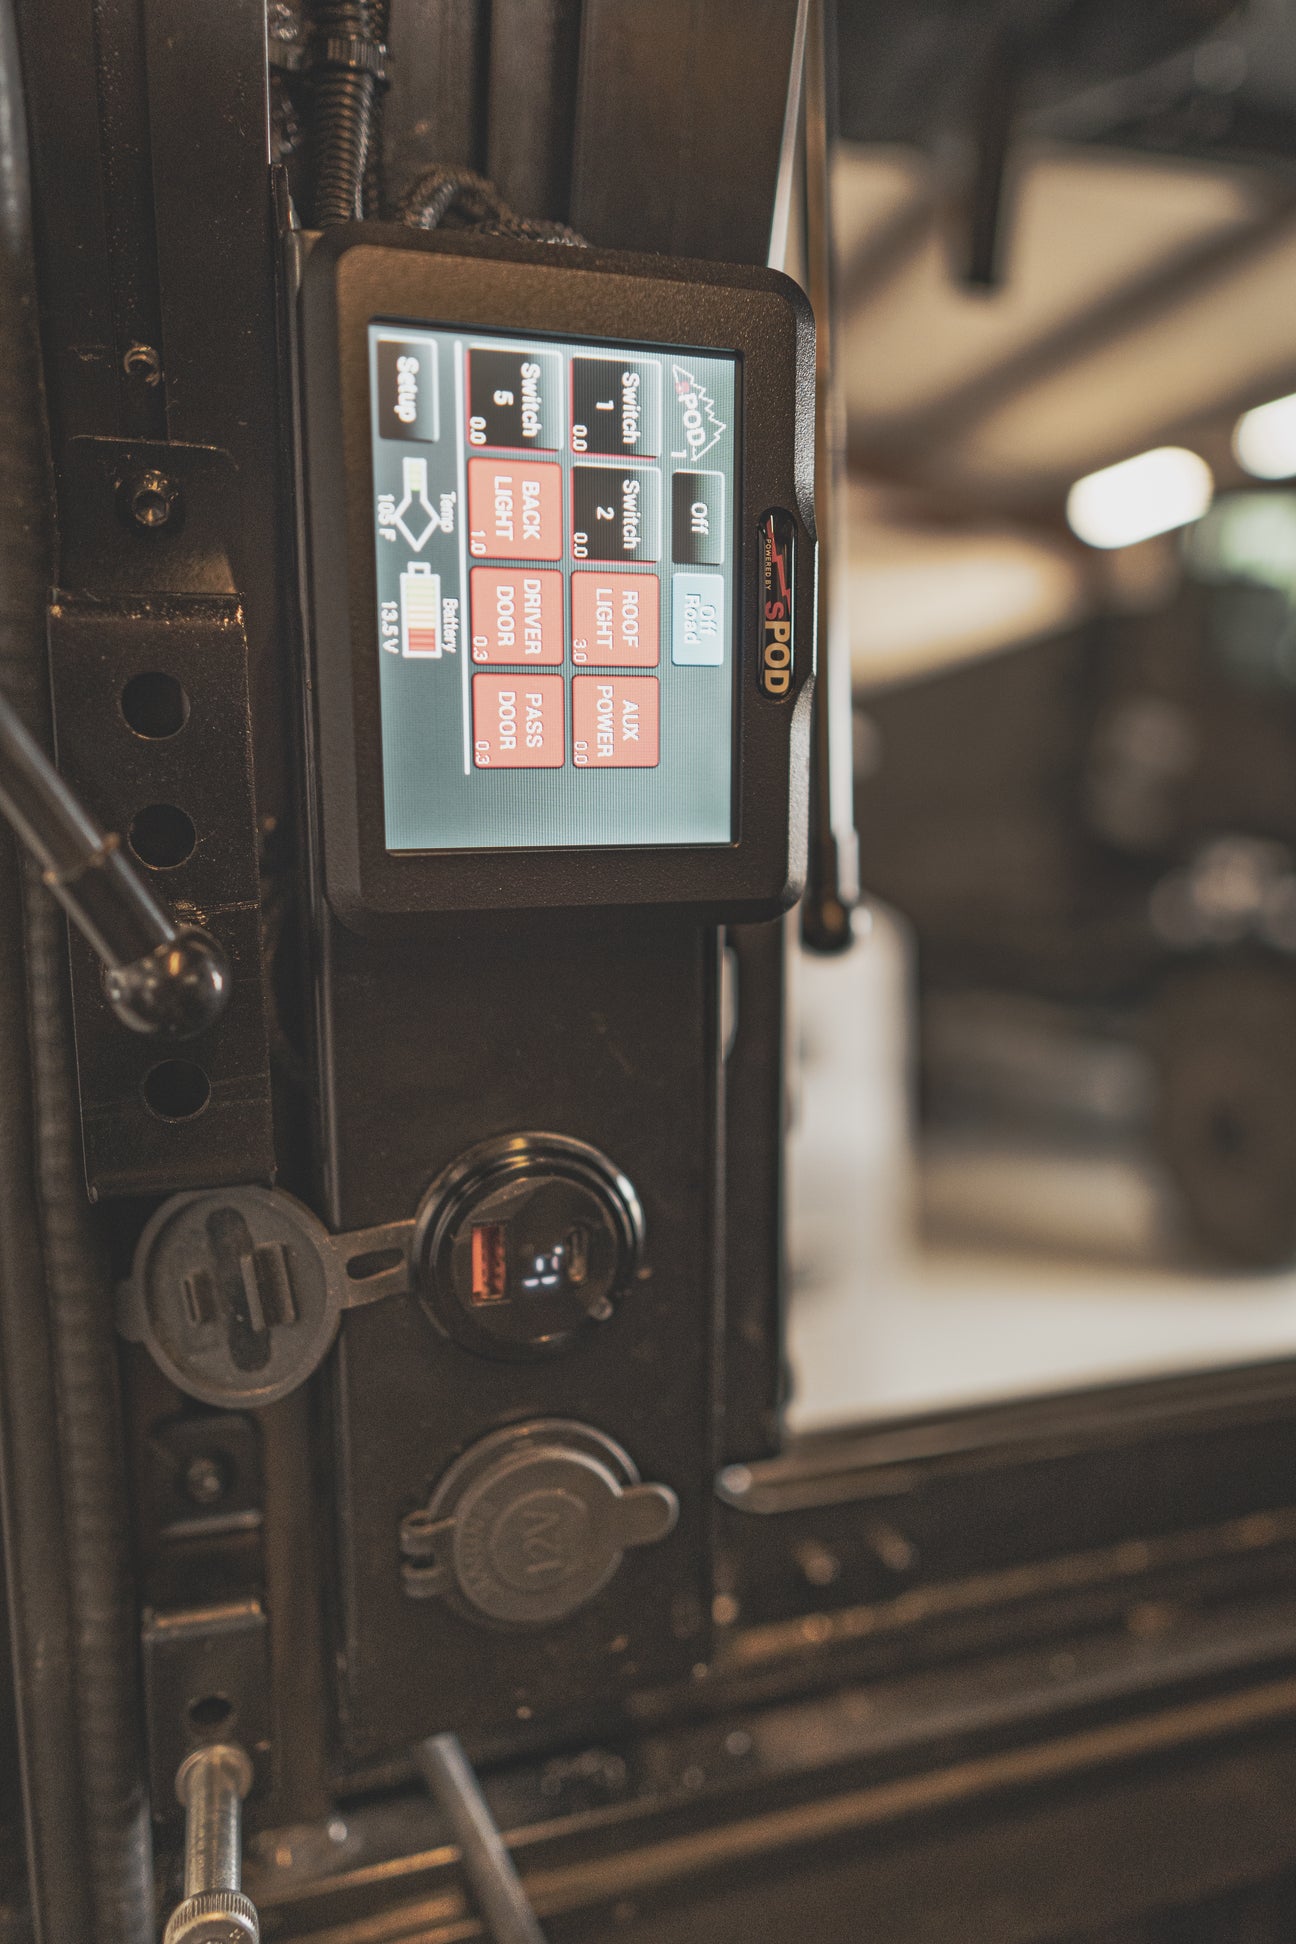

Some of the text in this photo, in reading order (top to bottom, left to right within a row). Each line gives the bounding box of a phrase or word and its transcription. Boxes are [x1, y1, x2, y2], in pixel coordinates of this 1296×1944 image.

[394, 356, 419, 423] Setup
[493, 390, 514, 406] 5
[520, 362, 542, 438] Switch
[595, 400, 615, 411] 1
[621, 371, 641, 445] Switch
[469, 416, 487, 445] 0.0
[572, 424, 588, 452] 0.0
[671, 448, 687, 458] 1
[439, 491, 456, 533] Temp
[494, 475, 513, 541] LIGHT
[521, 480, 541, 540] BACK
[595, 506, 615, 521] 2
[621, 479, 641, 550] Switch
[690, 502, 709, 536] Off
[378, 528, 397, 541] F
[470, 530, 486, 555] 1.0
[573, 531, 588, 558] 0.0
[764, 538, 772, 591] POWERED BY
[381, 601, 399, 654] 13.5 V
[441, 598, 459, 654] Battery
[496, 585, 515, 647] DOOR
[523, 578, 542, 655] DRIVER
[595, 588, 613, 650] LIGHT
[621, 590, 639, 648] ROOF
[684, 593, 702, 645] Road
[700, 604, 718, 637] Off
[473, 635, 488, 661] 0.3
[573, 638, 587, 663] 3.0
[498, 691, 516, 750] DOOR
[525, 692, 543, 748] PASS
[596, 685, 614, 757] POWER
[621, 699, 640, 741] AUX
[475, 740, 490, 765] 0.3
[574, 740, 588, 764] 0.0
